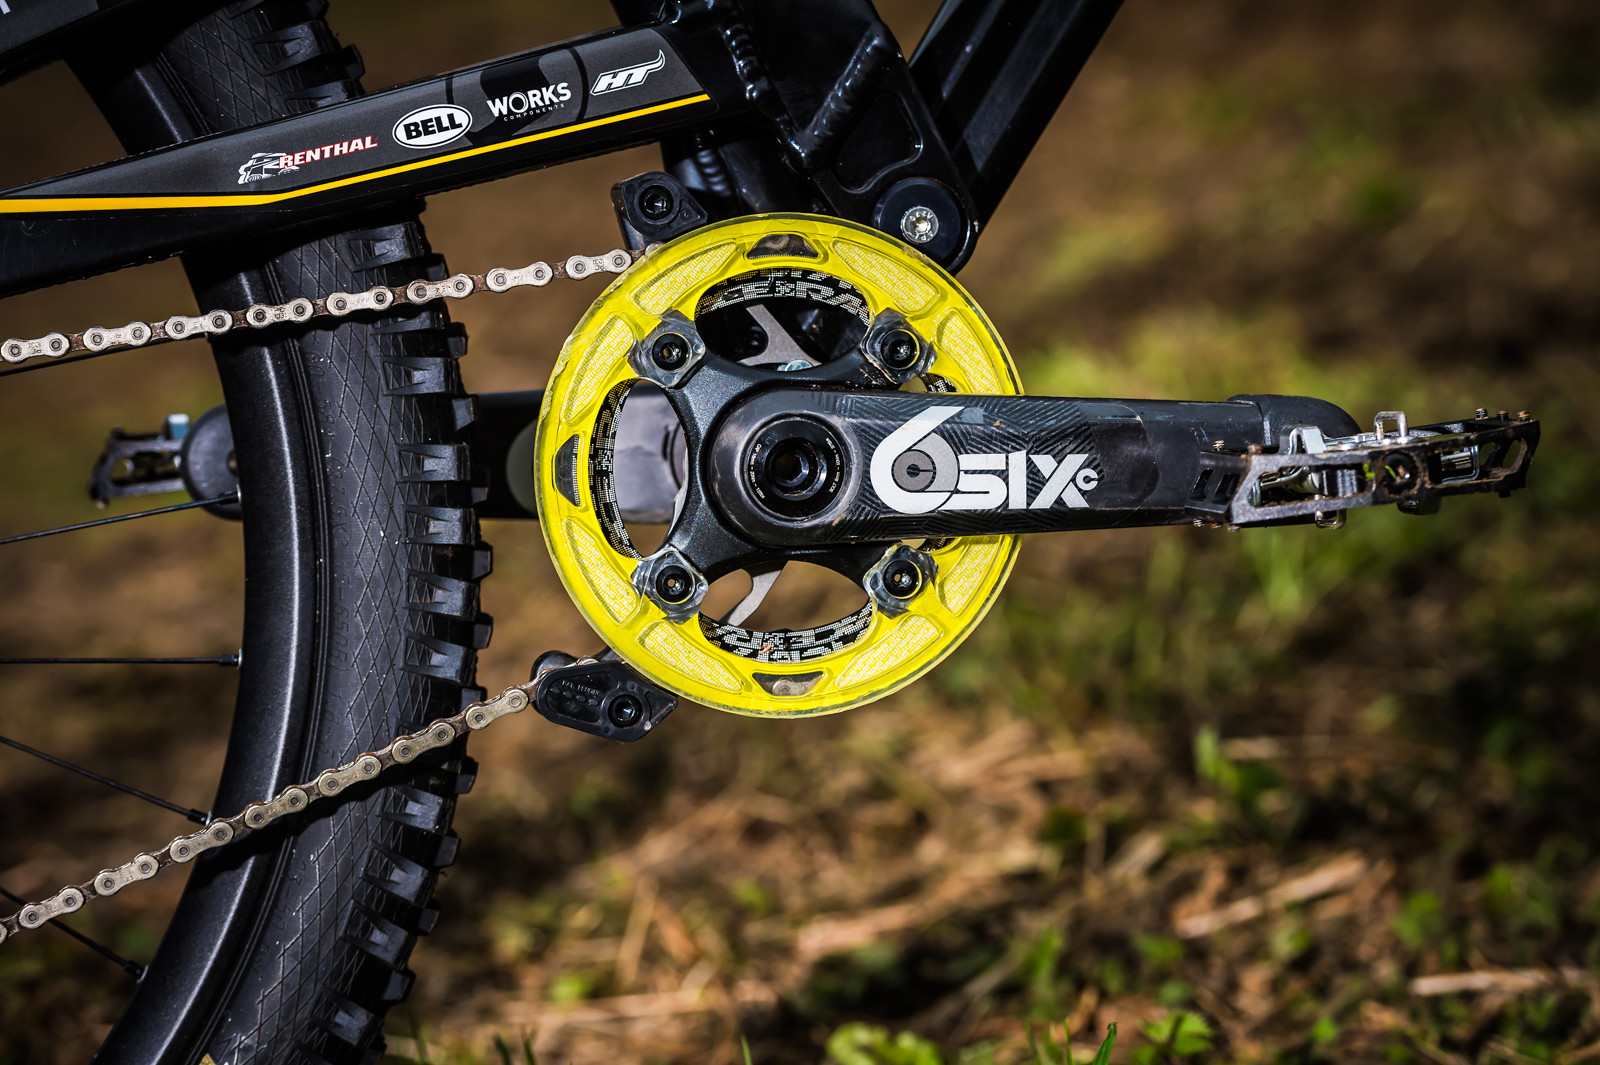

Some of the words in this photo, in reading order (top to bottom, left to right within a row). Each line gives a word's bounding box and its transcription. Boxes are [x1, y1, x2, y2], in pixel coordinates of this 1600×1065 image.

[591, 50, 665, 95] HT
[486, 82, 572, 117] WORKS
[504, 103, 566, 122] COMPONENTS
[403, 113, 463, 140] BELL
[279, 135, 378, 169] RENTHAL
